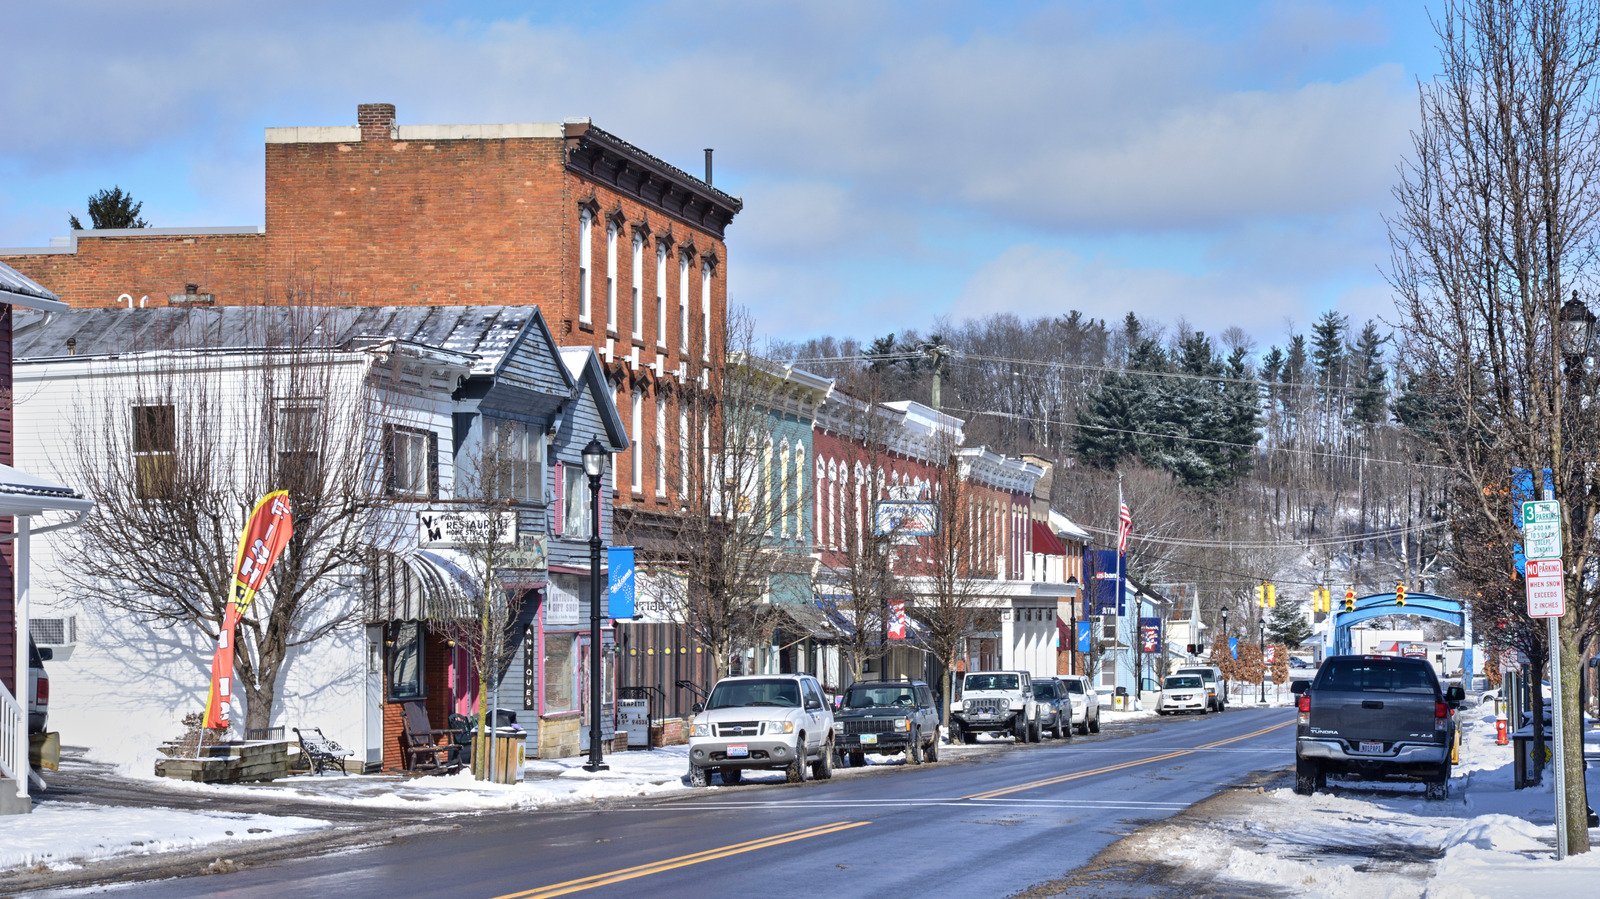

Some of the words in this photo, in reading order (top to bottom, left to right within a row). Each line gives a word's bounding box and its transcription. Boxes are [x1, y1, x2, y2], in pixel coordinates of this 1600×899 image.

[1526, 506, 1534, 520] 3
[1535, 512, 1558, 521] PARKING
[422, 515, 432, 529] V
[428, 527, 442, 542] M
[1527, 563, 1538, 576] NO
[1539, 564, 1560, 573] PARKING
[1546, 580, 1561, 588] SNOW
[1534, 591, 1558, 599] EXCEEDS
[1539, 601, 1559, 609] INCHES
[525, 628, 533, 706] ANTIQUES
